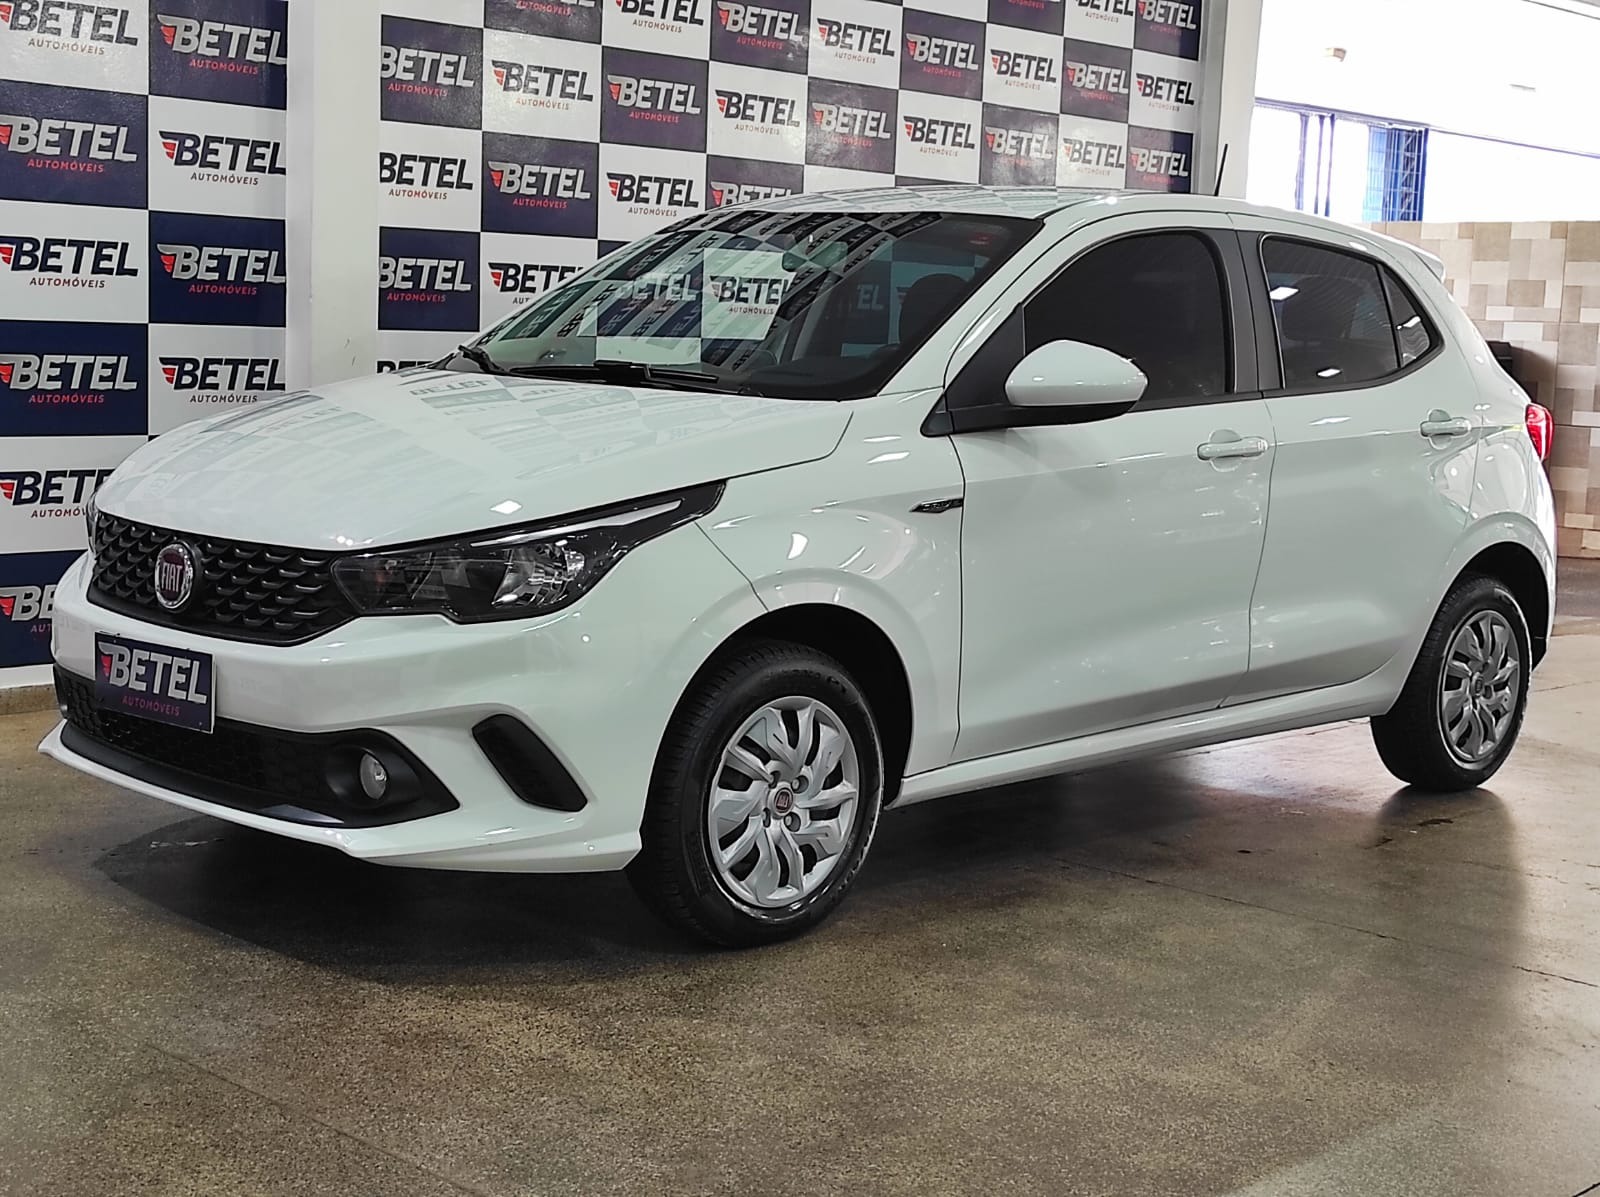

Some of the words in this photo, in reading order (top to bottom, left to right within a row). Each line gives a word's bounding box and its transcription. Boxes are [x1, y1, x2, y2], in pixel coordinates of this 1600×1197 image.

[3, 0, 138, 46] BETEL
[632, 19, 682, 34] AUTOMÓVEIS
[717, 1, 802, 41] BETEL
[1137, 0, 1197, 30] BETEL
[28, 38, 105, 55] AUTOMÓVEIS
[157, 14, 287, 65] BETEL
[736, 36, 783, 50] AUTOMÓVEIS
[817, 17, 895, 57] BETEL
[906, 33, 979, 71] BETEL
[189, 58, 259, 75] AUTOMÓVEIS
[381, 45, 474, 88] BETEL
[491, 59, 593, 102] BETEL
[990, 49, 1057, 84] BETEL
[1066, 60, 1129, 95] BETEL
[388, 82, 448, 97] AUTOMÓVEIS
[516, 98, 570, 111] AUTOMÓVEIS
[608, 74, 700, 115] BETEL
[1136, 72, 1195, 106] BETEL
[629, 110, 680, 124] AUTOMÓVEIS
[715, 89, 801, 128] BETEL
[812, 102, 891, 139] BETEL
[0, 113, 138, 163] BETEL
[734, 123, 780, 135] AUTOMÓVEIS
[903, 115, 975, 150] BETEL
[985, 126, 1053, 160] BETEL
[27, 158, 105, 173] AUTOMÓVEIS
[159, 130, 286, 176] BETEL
[1063, 137, 1125, 170] BETEL
[1129, 146, 1189, 178] BETEL
[190, 171, 259, 186] AUTOMÓVEIS
[379, 151, 473, 190] BETEL
[488, 160, 592, 200] BETEL
[388, 188, 448, 200] AUTOMÓVEIS
[512, 198, 568, 209] AUTOMÓVEIS
[606, 172, 699, 208] BETEL
[628, 206, 678, 217] AUTOMÓVEIS
[0, 235, 139, 277] BETEL
[157, 243, 286, 284] BETEL
[29, 276, 106, 288] AUTOMÓVEIS
[188, 284, 258, 296] AUTOMÓVEIS
[379, 256, 473, 292] BETEL
[488, 262, 584, 294] BETE
[387, 293, 447, 303] AUTOMÓVEIS
[729, 306, 774, 316] AUTOMÓVEIS
[0, 353, 138, 390] BETEL
[159, 356, 286, 391] BETEL
[28, 393, 105, 404] AUTOMÓVEIS
[190, 394, 259, 404] AUTOMÓVEIS
[161, 562, 183, 593] FIAT
[98, 641, 208, 705] BETEL
[121, 695, 181, 717] AUTOMÓVEIS
